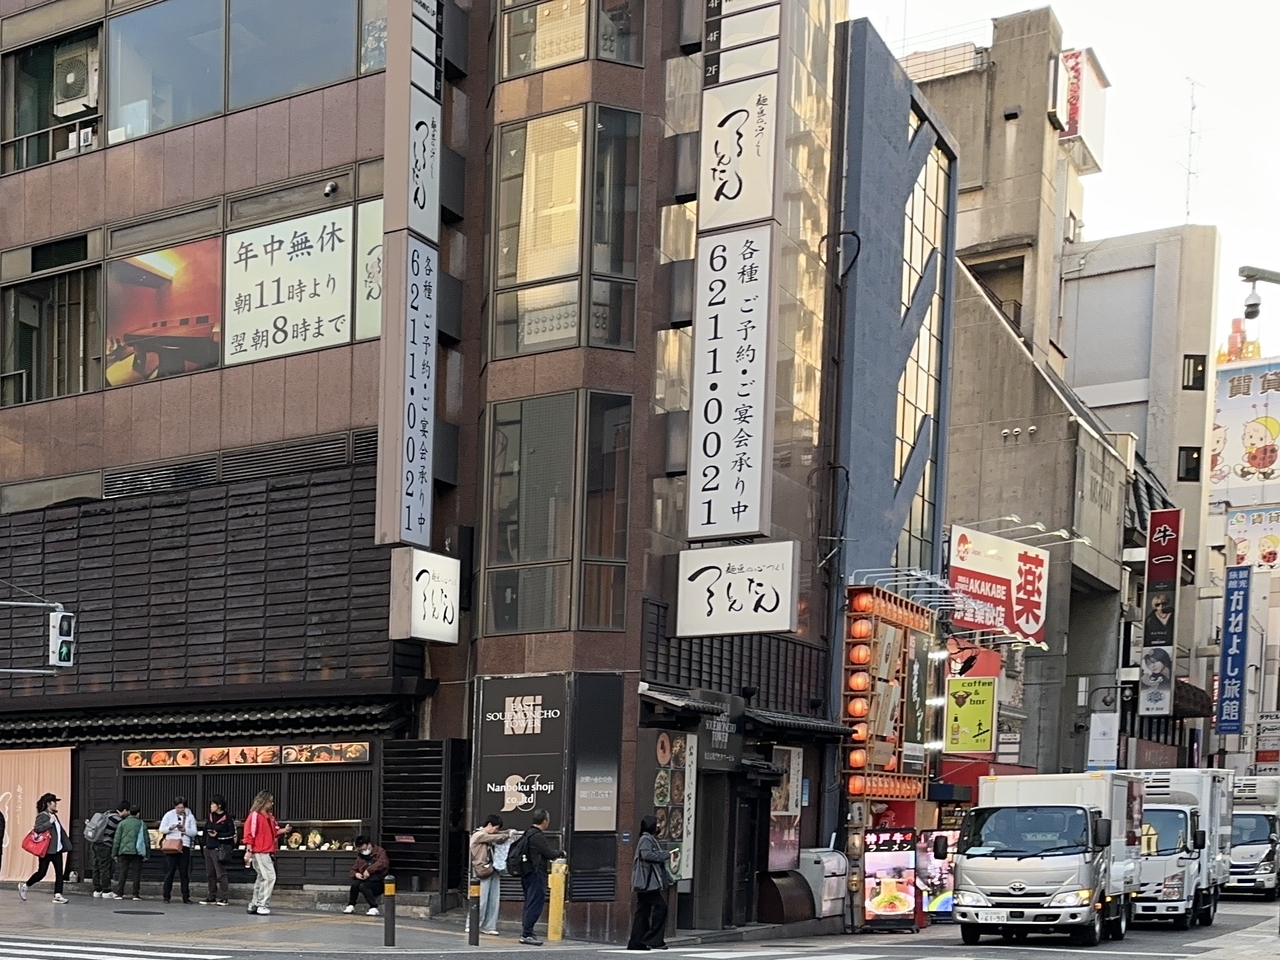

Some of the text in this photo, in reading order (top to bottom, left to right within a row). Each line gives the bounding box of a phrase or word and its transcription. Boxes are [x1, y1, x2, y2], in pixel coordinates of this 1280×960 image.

[707, 30, 719, 42] 4F
[706, 64, 718, 77] 2F
[233, 222, 345, 272] 年中無休
[737, 239, 760, 283] 各種
[423, 256, 434, 301] 各種
[233, 273, 336, 315] 朝11時より
[230, 315, 346, 355] 翌朝8時まで
[1152, 525, 1177, 564] 牛一
[968, 578, 1007, 600] AKAKABE
[1016, 551, 1044, 625] 薬
[1222, 591, 1244, 720] かねよし旅館
[486, 709, 560, 721] SOUEMONCHO
[511, 702, 536, 711] EAST
[504, 720, 542, 729] TOWER
[486, 781, 554, 794] Nanboku shoji
[868, 843, 911, 851] ラーメン
